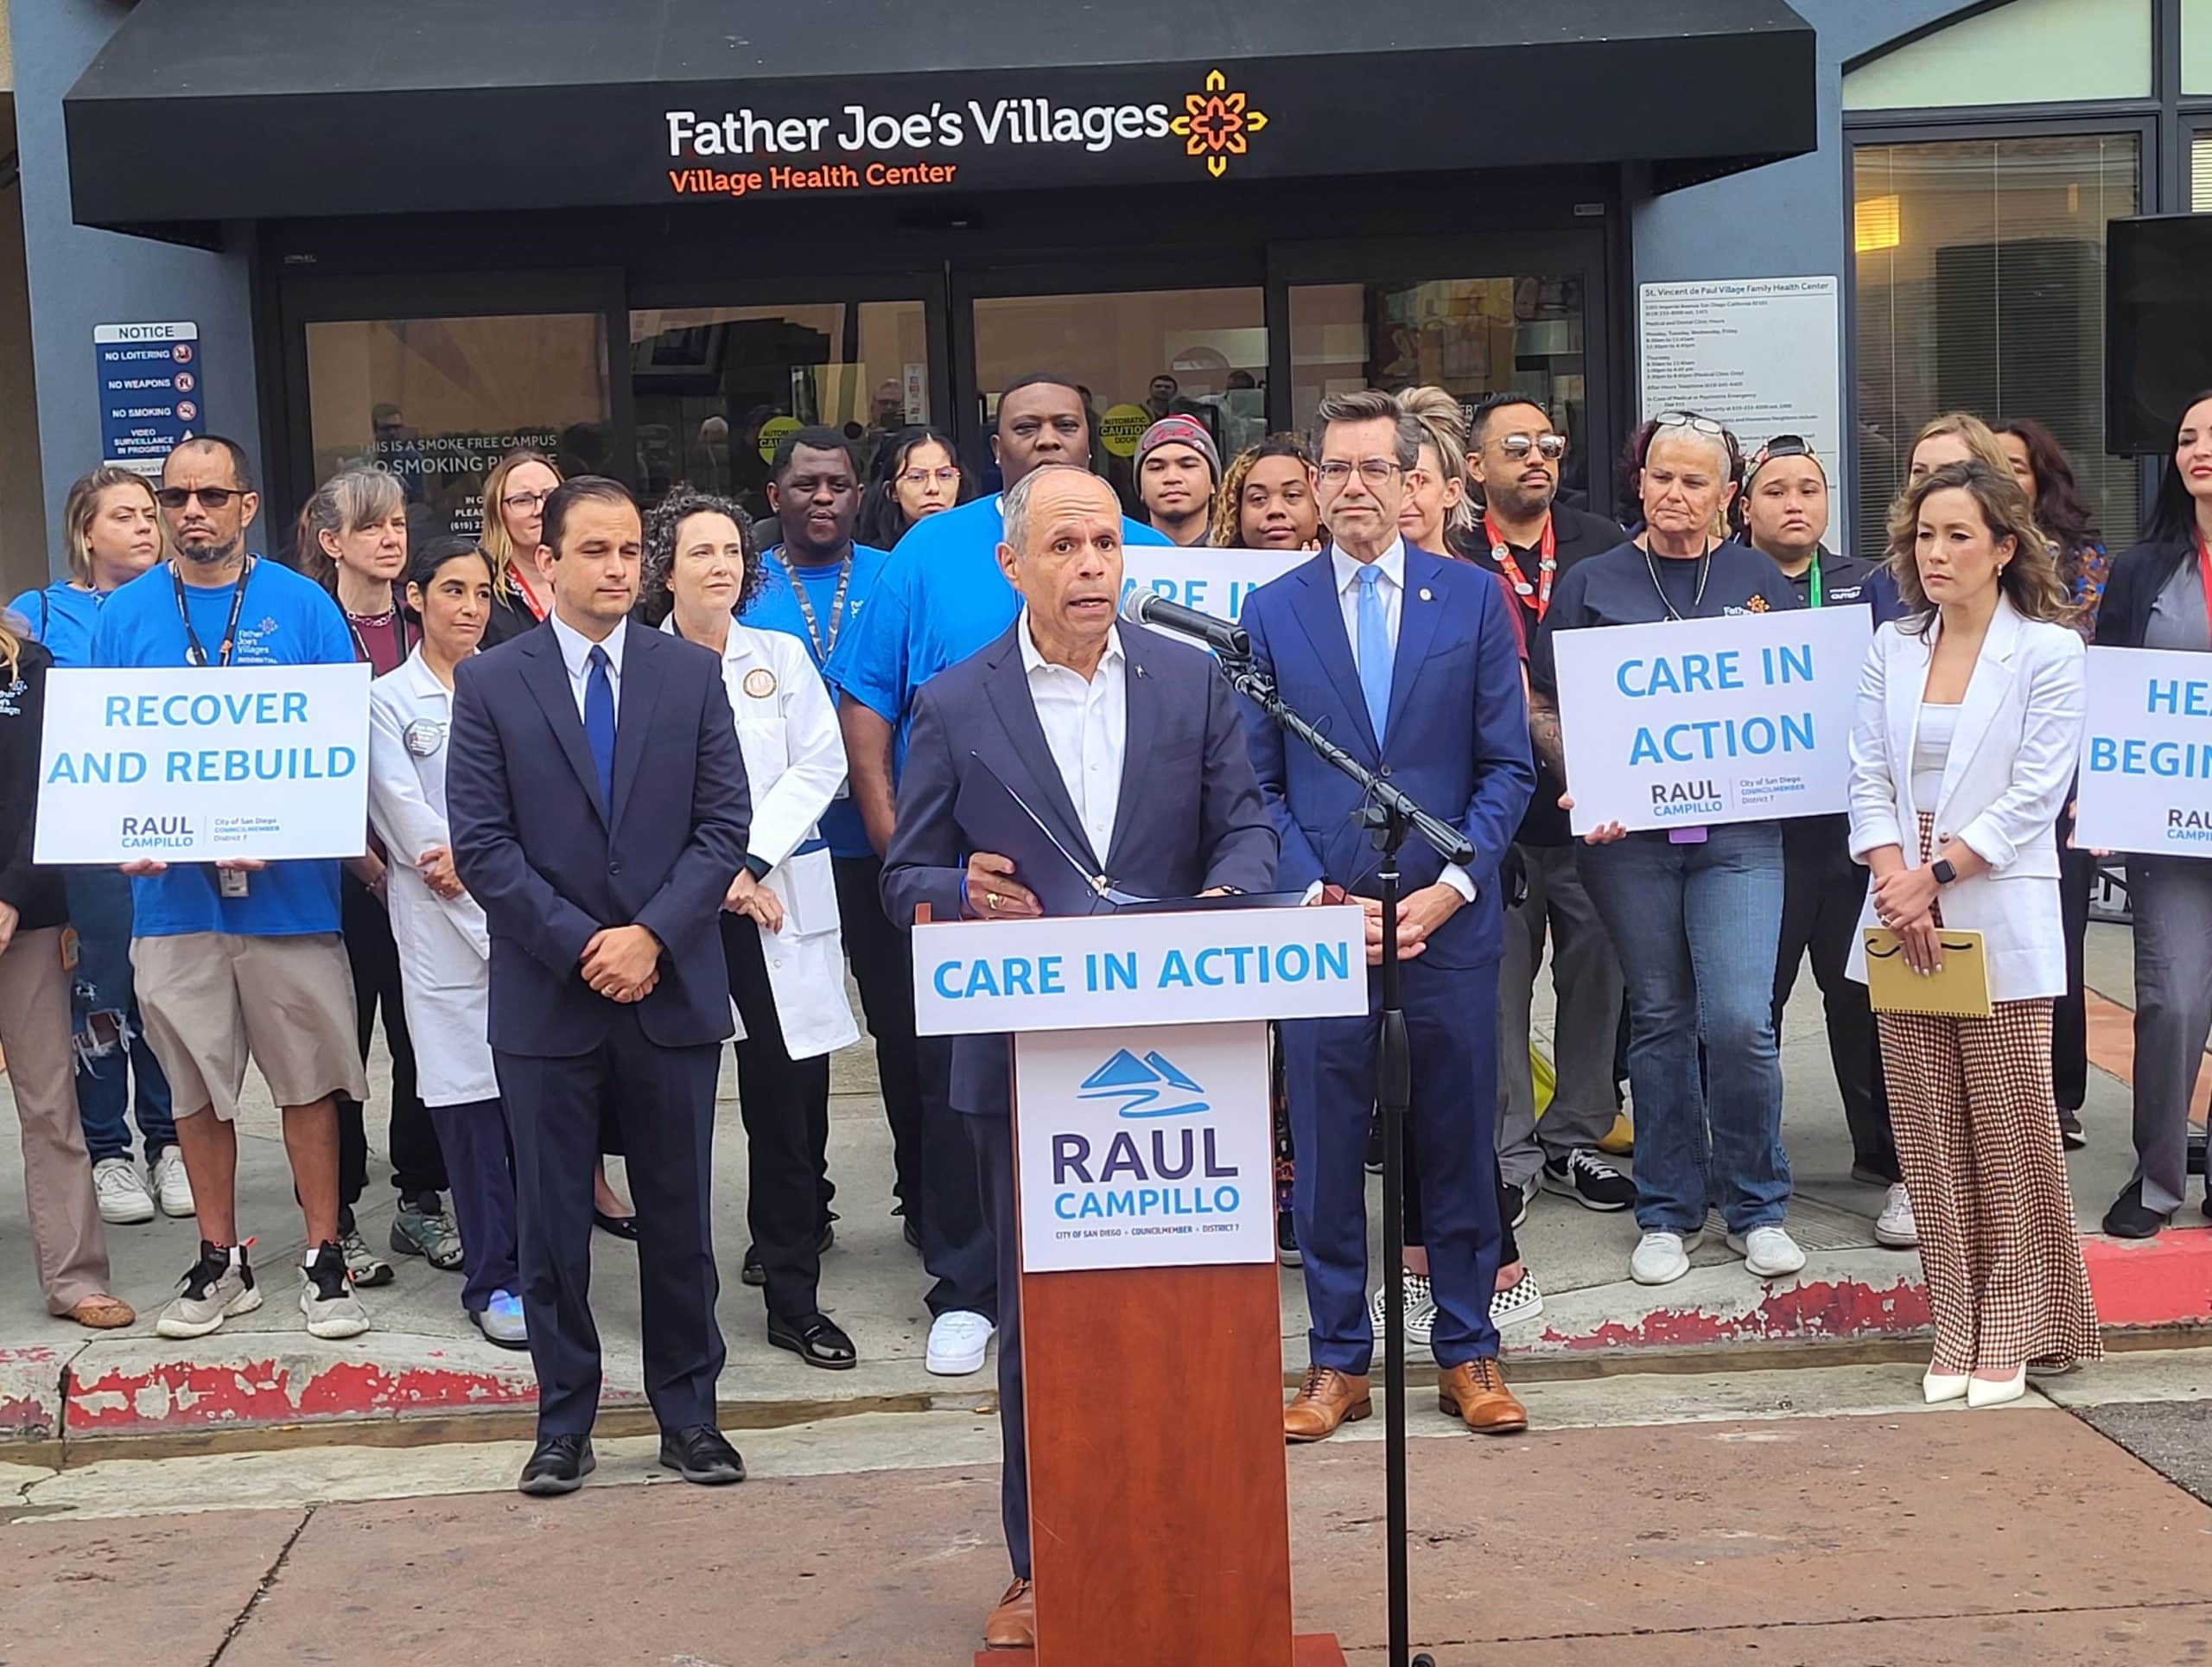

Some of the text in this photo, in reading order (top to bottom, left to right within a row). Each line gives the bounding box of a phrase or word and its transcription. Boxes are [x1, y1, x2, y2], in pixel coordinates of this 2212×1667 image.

[666, 99, 1170, 156] Father Joe's Villages
[669, 163, 957, 198] Village Health Center
[1658, 288, 1688, 296] Vincent
[1690, 287, 1700, 296] de
[1701, 286, 1717, 295] Paul
[1718, 285, 1745, 295] Village
[1747, 283, 1771, 295] Family
[1773, 283, 1800, 292] Health
[1802, 281, 1829, 291] Center
[119, 326, 175, 338] NOTICE
[121, 350, 170, 360] LOITERING
[124, 379, 171, 389] WEAPONS
[129, 407, 171, 417] SMOKING
[113, 436, 175, 446] SURVEILLANCE
[118, 445, 172, 455] IN PROGRESS
[391, 441, 403, 451] IS
[405, 440, 416, 451] A
[417, 437, 465, 450] SMOKE
[467, 436, 499, 449] FREE
[502, 435, 557, 448] CAMPUS
[393, 455, 483, 475] SMOKING
[1617, 645, 1814, 697] CARE IN
[2148, 679, 2212, 716] HE
[105, 692, 308, 727] RECOVER
[1629, 712, 1815, 766] ACTION
[48, 746, 356, 784] AND REBUILD
[1650, 779, 1721, 804] RAUL
[1742, 795, 1768, 804] District
[1653, 801, 1723, 817] CAMPILLO
[122, 816, 194, 835] RAUL
[122, 837, 194, 848] CAMPILLO
[933, 941, 1350, 999] CARE IN ACTION
[1052, 1127, 1238, 1185] RAUL
[1054, 1185, 1240, 1220] CAMPILLO
[1056, 1231, 1071, 1239] CITY
[1100, 1228, 1122, 1238] DIEGO
[1131, 1225, 1193, 1236] COUNCILMEMBER
[1203, 1223, 1233, 1233] DISTRICT
